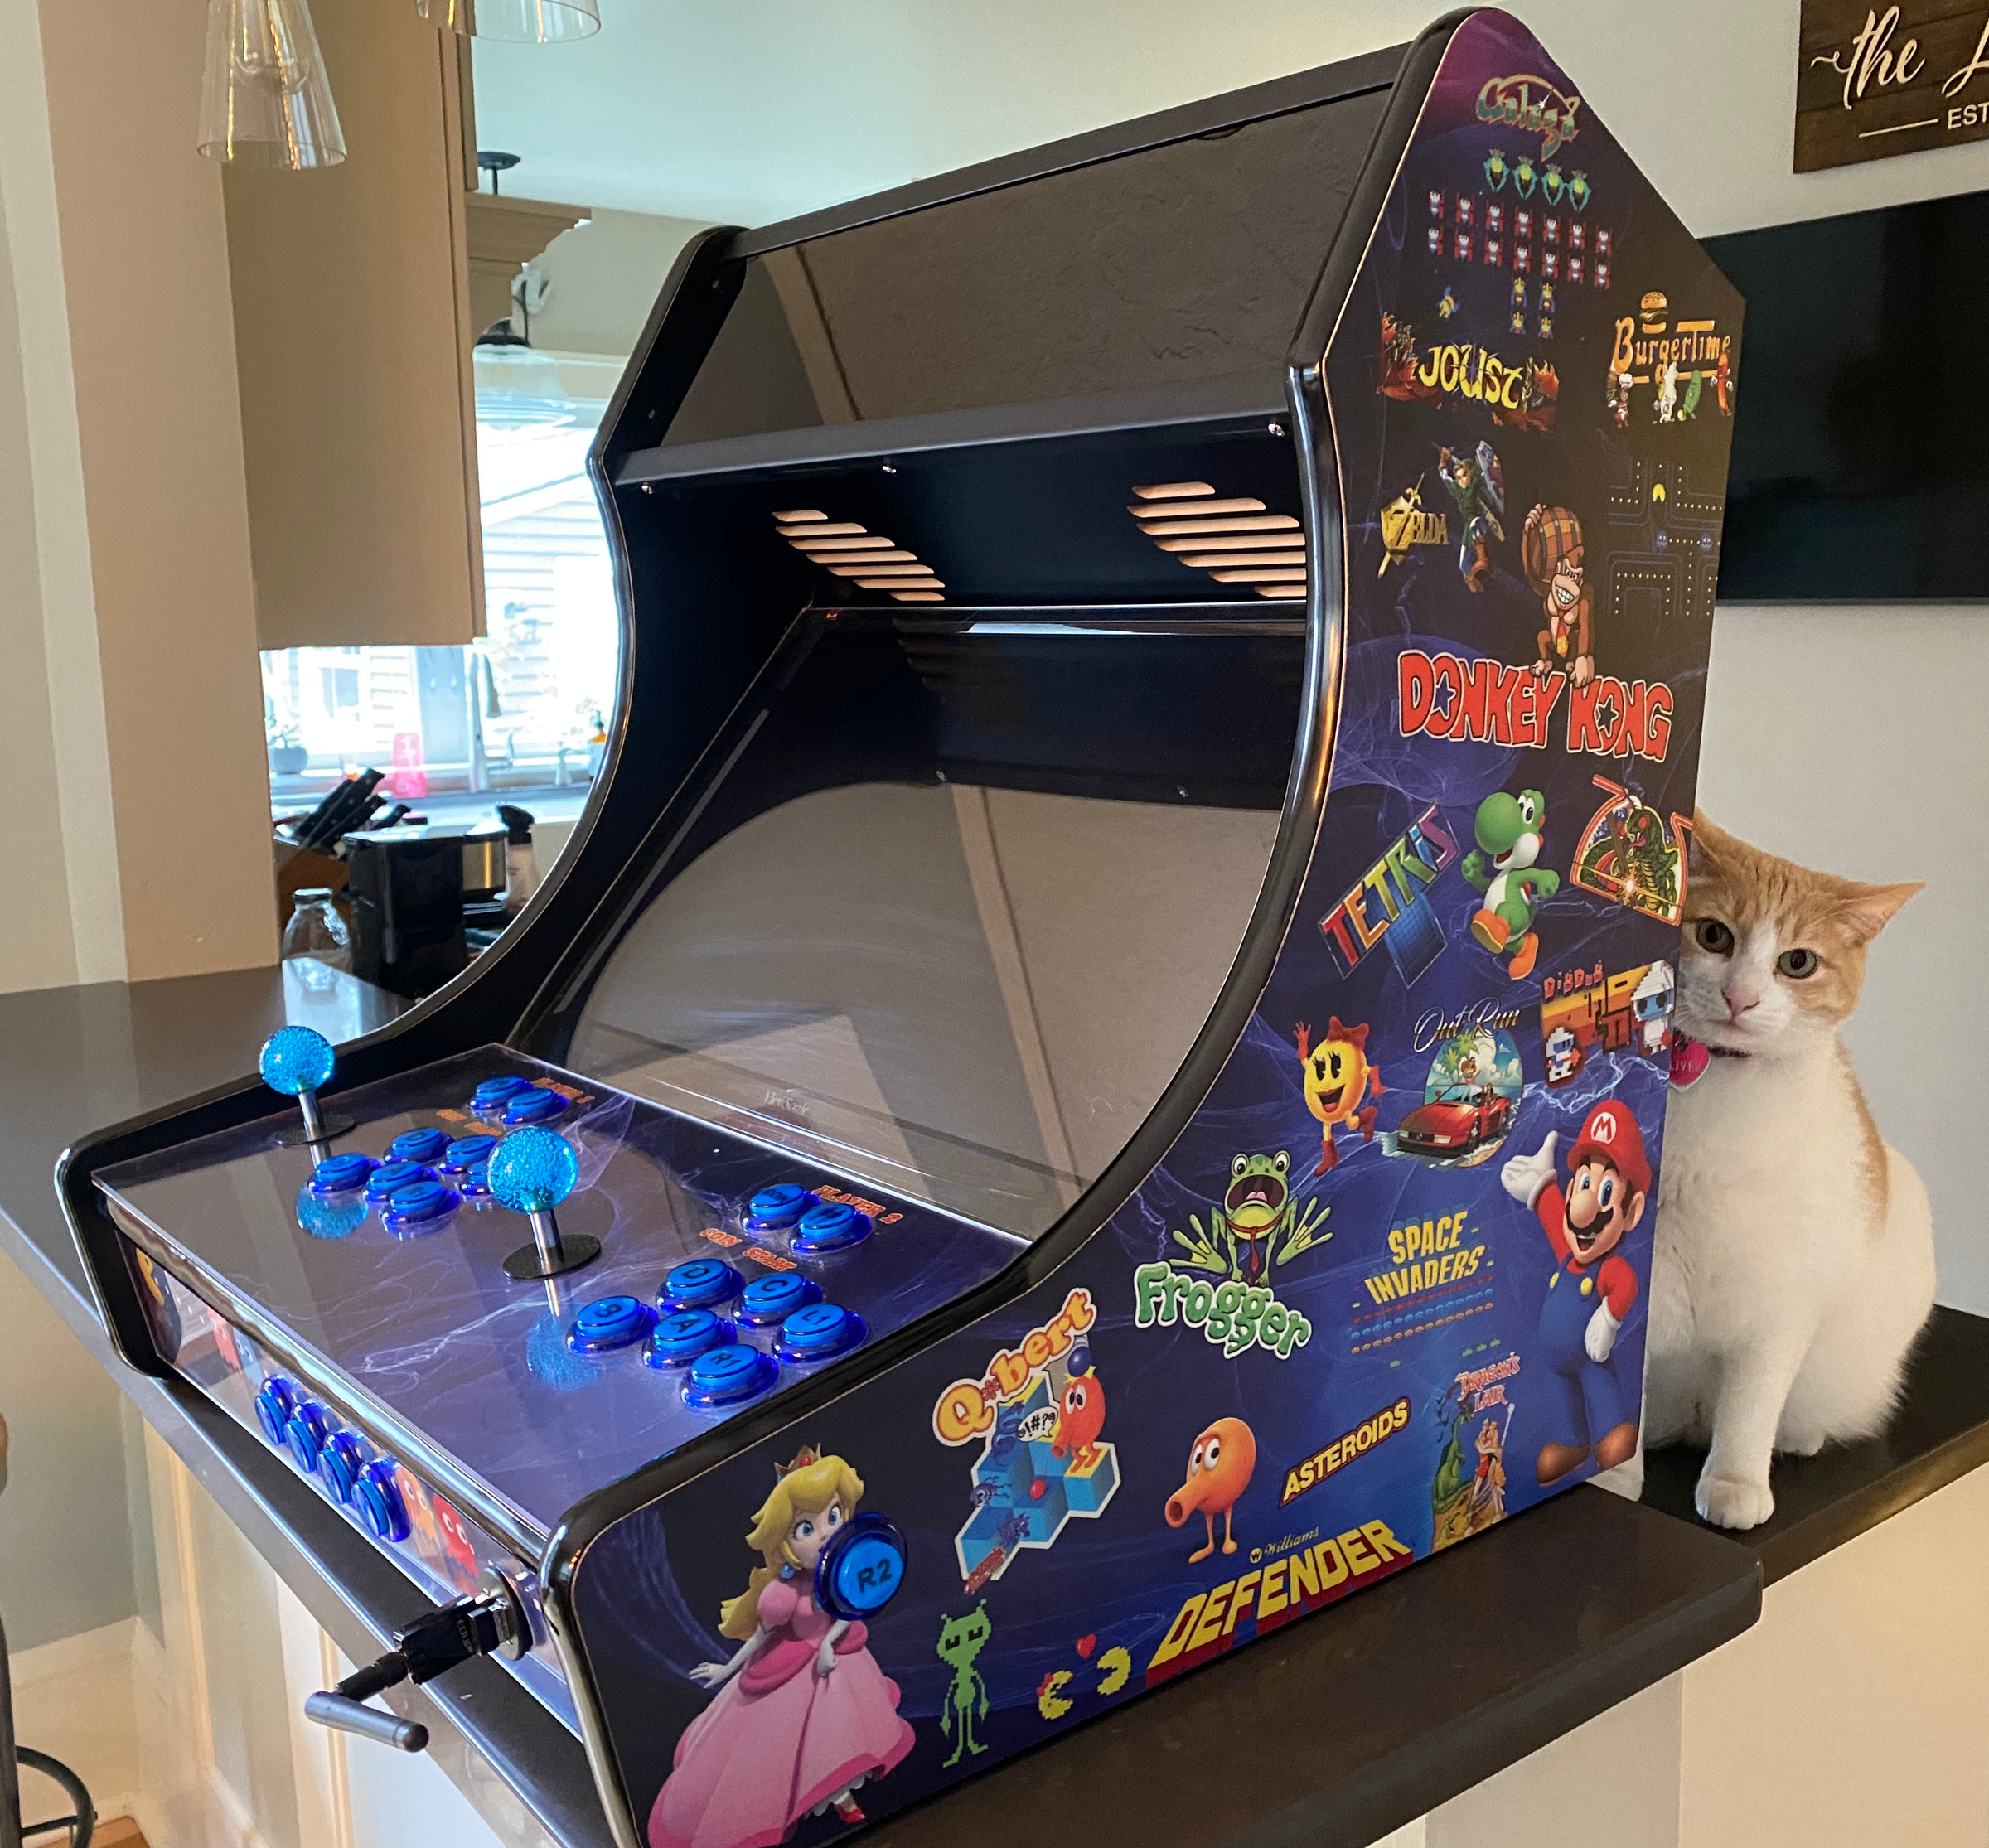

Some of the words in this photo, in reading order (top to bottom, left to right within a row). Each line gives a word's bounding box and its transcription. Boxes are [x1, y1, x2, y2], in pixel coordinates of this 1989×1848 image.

[1811, 6, 1925, 110] the
[1398, 649, 1565, 749] DONKEY
[1566, 677, 1674, 762] KONG
[1414, 1005, 1469, 1052] Out
[1468, 997, 1520, 1039] Run
[764, 1090, 810, 1115] ViewSonic
[812, 1185, 886, 1217] PLAYER
[879, 1212, 903, 1224] 2
[699, 1228, 743, 1247] COIN
[1388, 1211, 1468, 1264] SPACE
[681, 1267, 709, 1279] D
[743, 1247, 798, 1272] START
[1364, 1245, 1485, 1304] INVADERS
[761, 1280, 788, 1291] C
[677, 1318, 699, 1333] A
[801, 1310, 830, 1326] L1
[1134, 1261, 1312, 1359] Frogger
[711, 1351, 742, 1368] R1
[1282, 1399, 1409, 1503] ASTEROIDS
[1264, 1526, 1319, 1555] Williams
[856, 1558, 893, 1594] R2
[1147, 1519, 1412, 1671] DEFENDER
